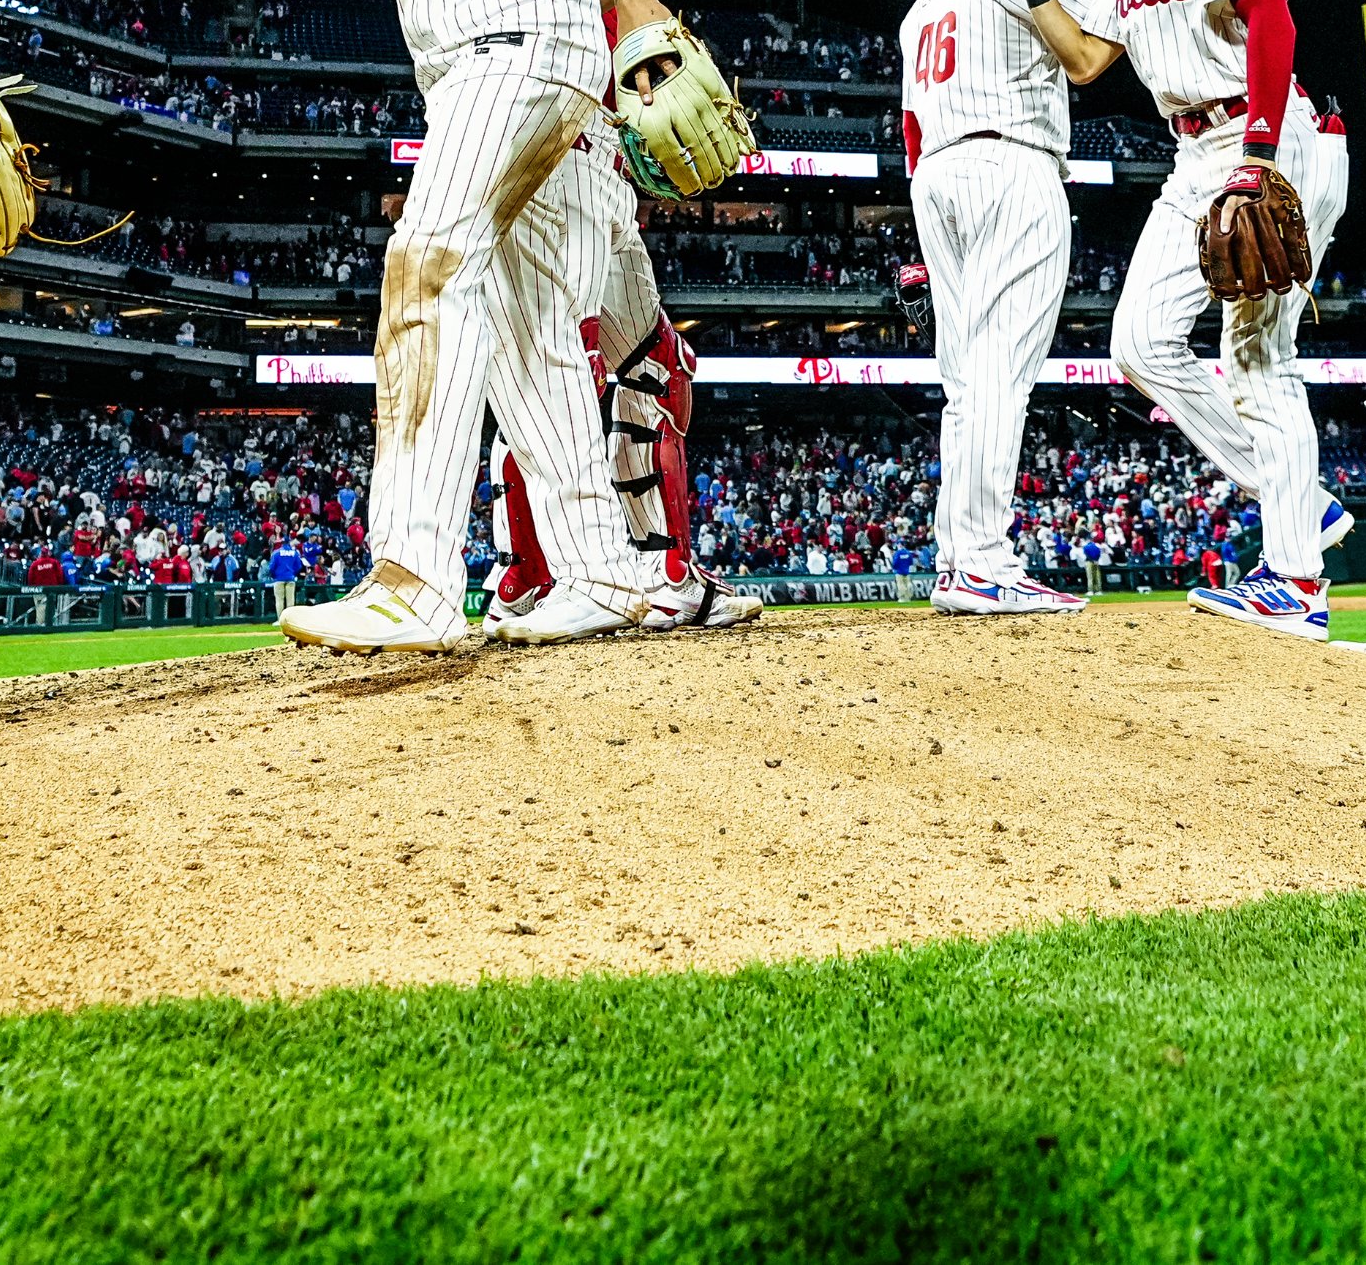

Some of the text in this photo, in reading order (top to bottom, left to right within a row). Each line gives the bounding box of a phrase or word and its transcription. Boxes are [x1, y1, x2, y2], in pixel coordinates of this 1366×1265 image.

[916, 10, 957, 93] 46
[1248, 125, 1271, 133] adidas
[504, 585, 514, 594] 10
[815, 580, 934, 603] MLB NETWRK
